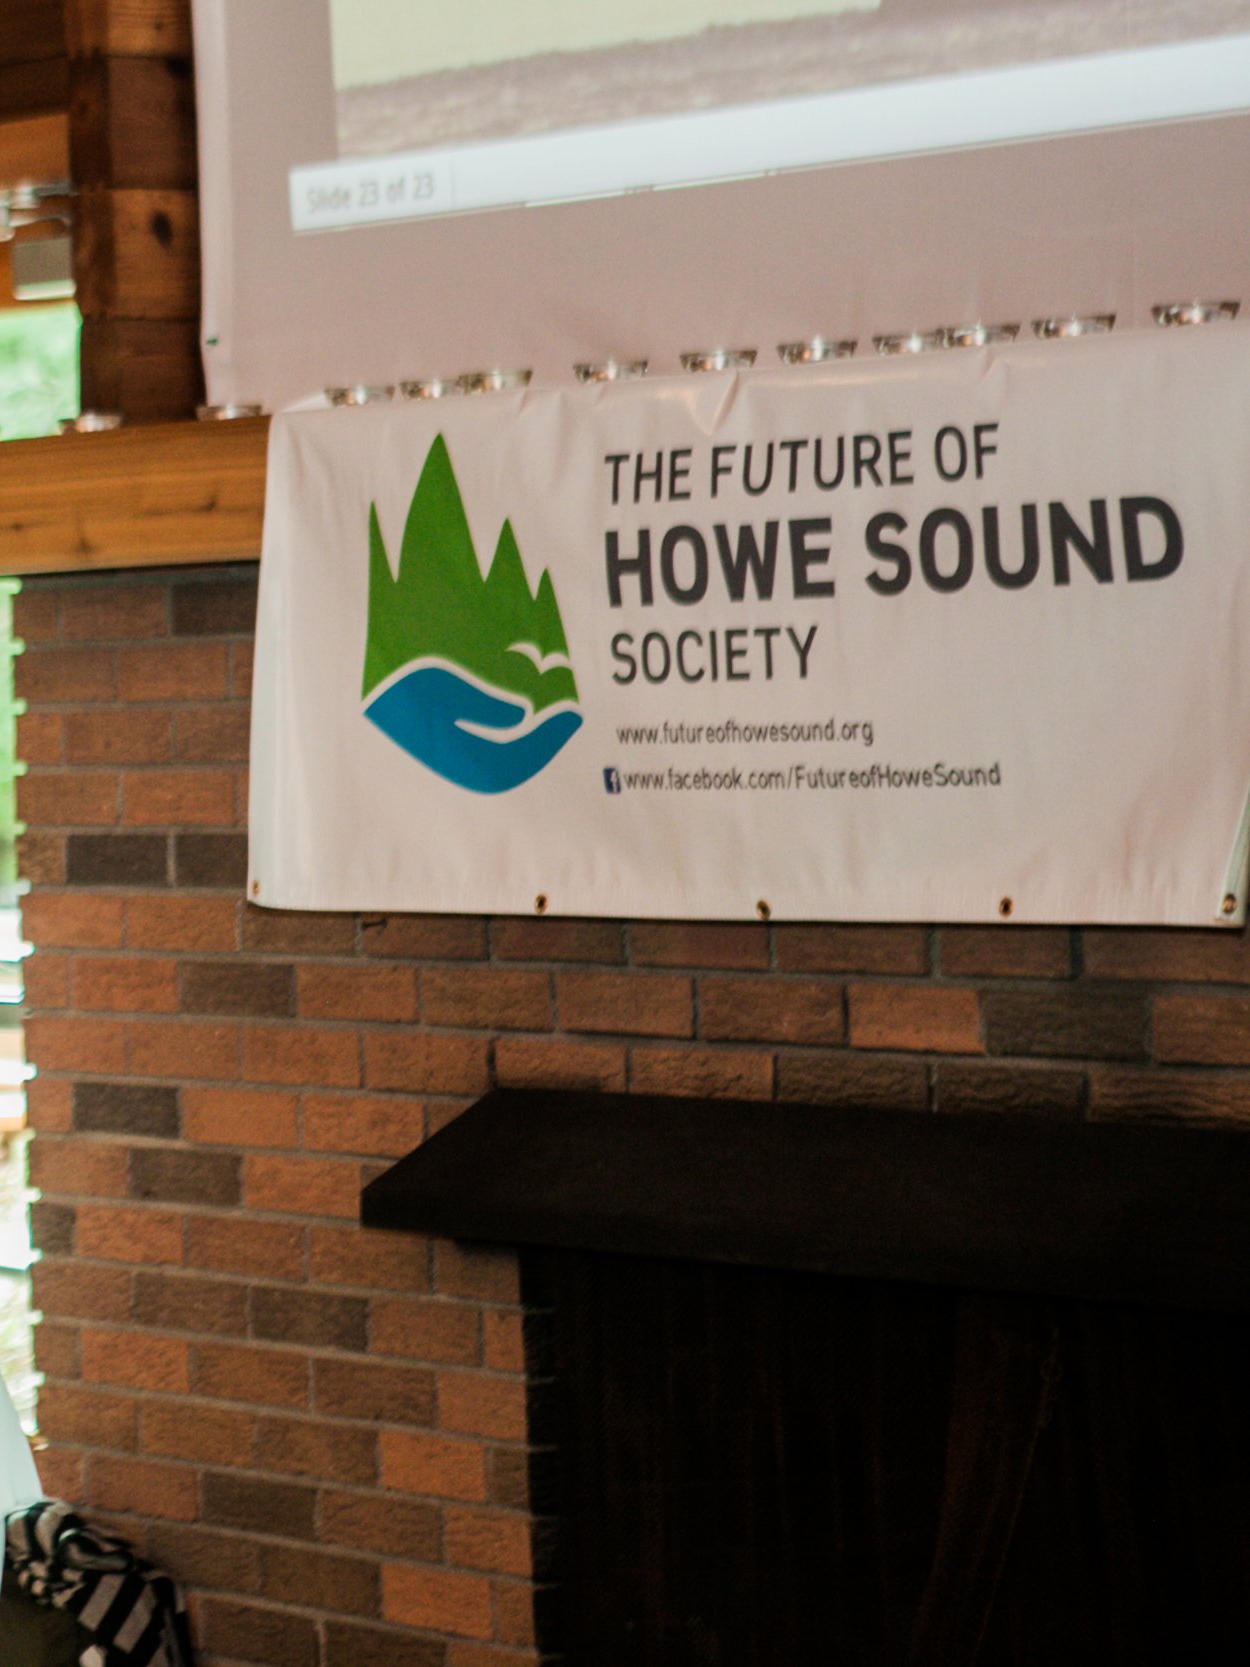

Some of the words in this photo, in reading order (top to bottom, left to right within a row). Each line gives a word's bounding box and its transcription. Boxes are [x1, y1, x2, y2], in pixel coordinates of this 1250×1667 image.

[358, 180, 379, 207] 23
[387, 175, 406, 204] of
[413, 172, 434, 200] 23
[604, 448, 693, 506] THE
[709, 430, 915, 499] FUTURE
[933, 422, 1000, 483] OF
[604, 516, 836, 609] HOWE
[863, 495, 1185, 597] SOUND
[609, 624, 819, 686] SOCIETY
[616, 718, 874, 747] www.futureofhowesound.org
[624, 762, 1002, 792] www.facebook.com/FutureofHoweSound
